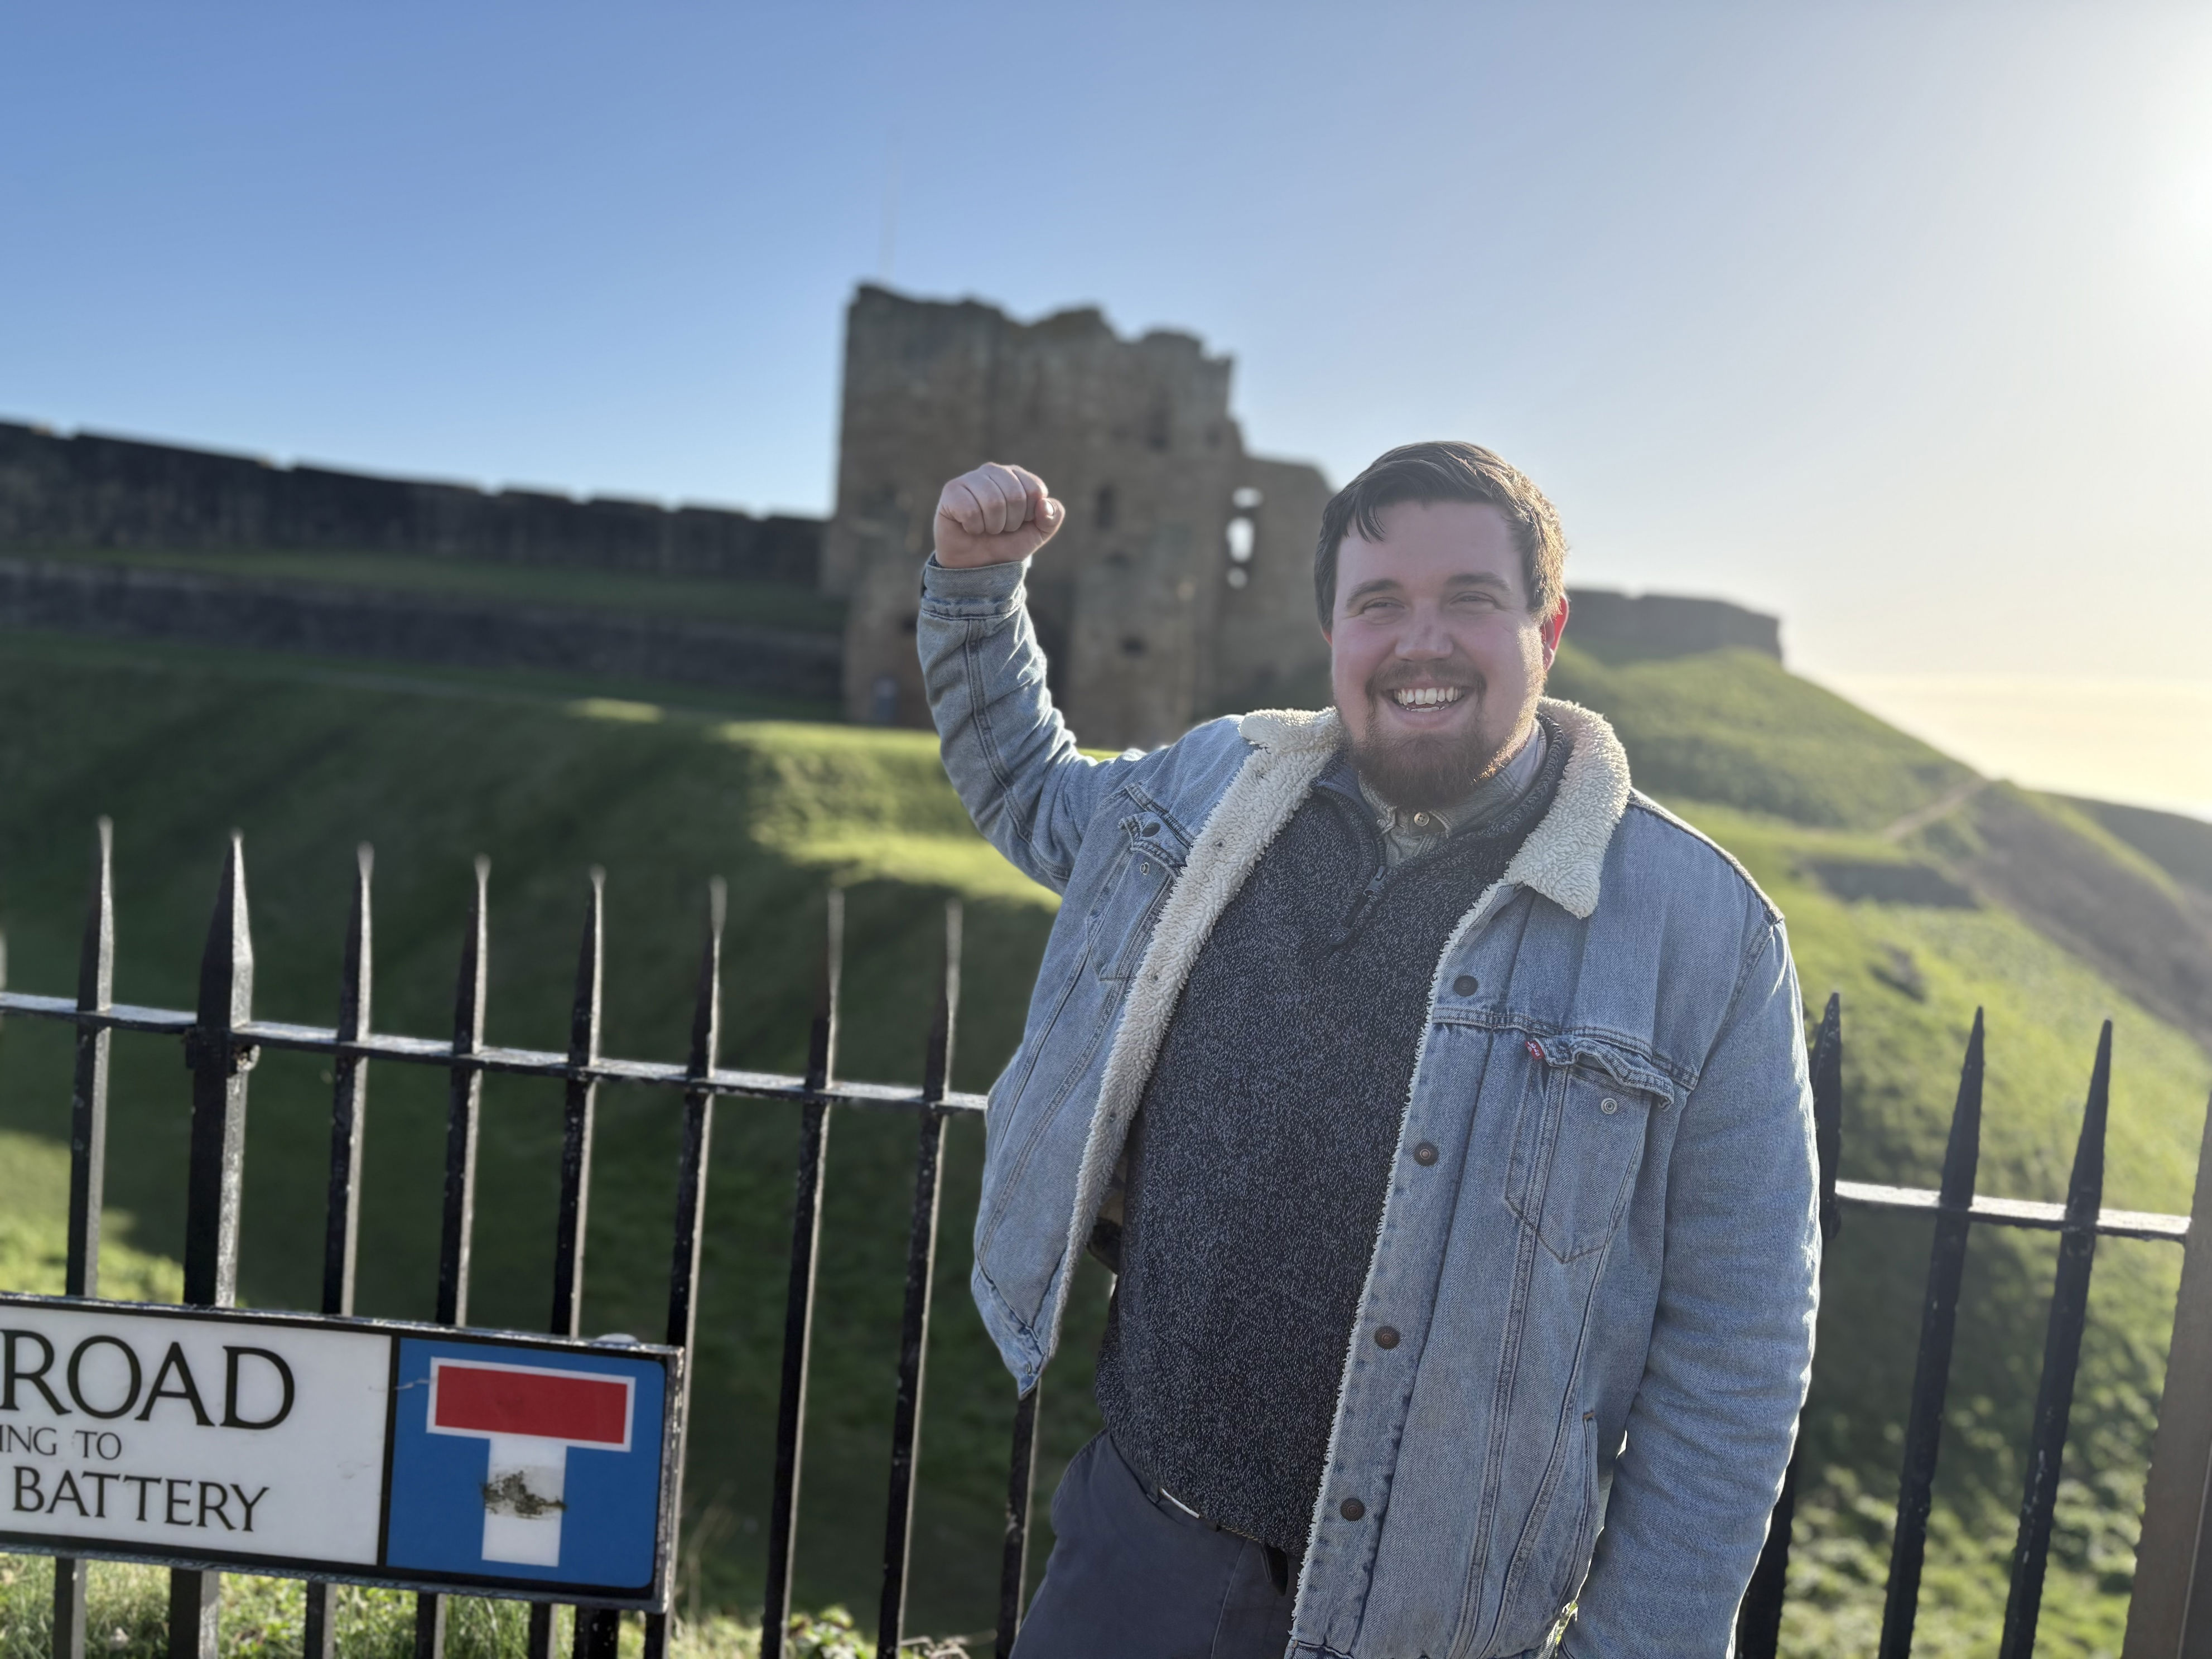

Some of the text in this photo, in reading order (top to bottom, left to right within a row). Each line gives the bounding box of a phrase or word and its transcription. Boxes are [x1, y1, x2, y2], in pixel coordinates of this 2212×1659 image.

[0, 1329, 295, 1430] ROAD
[0, 1424, 122, 1460] ING TO
[13, 1466, 270, 1532] BATTERY
